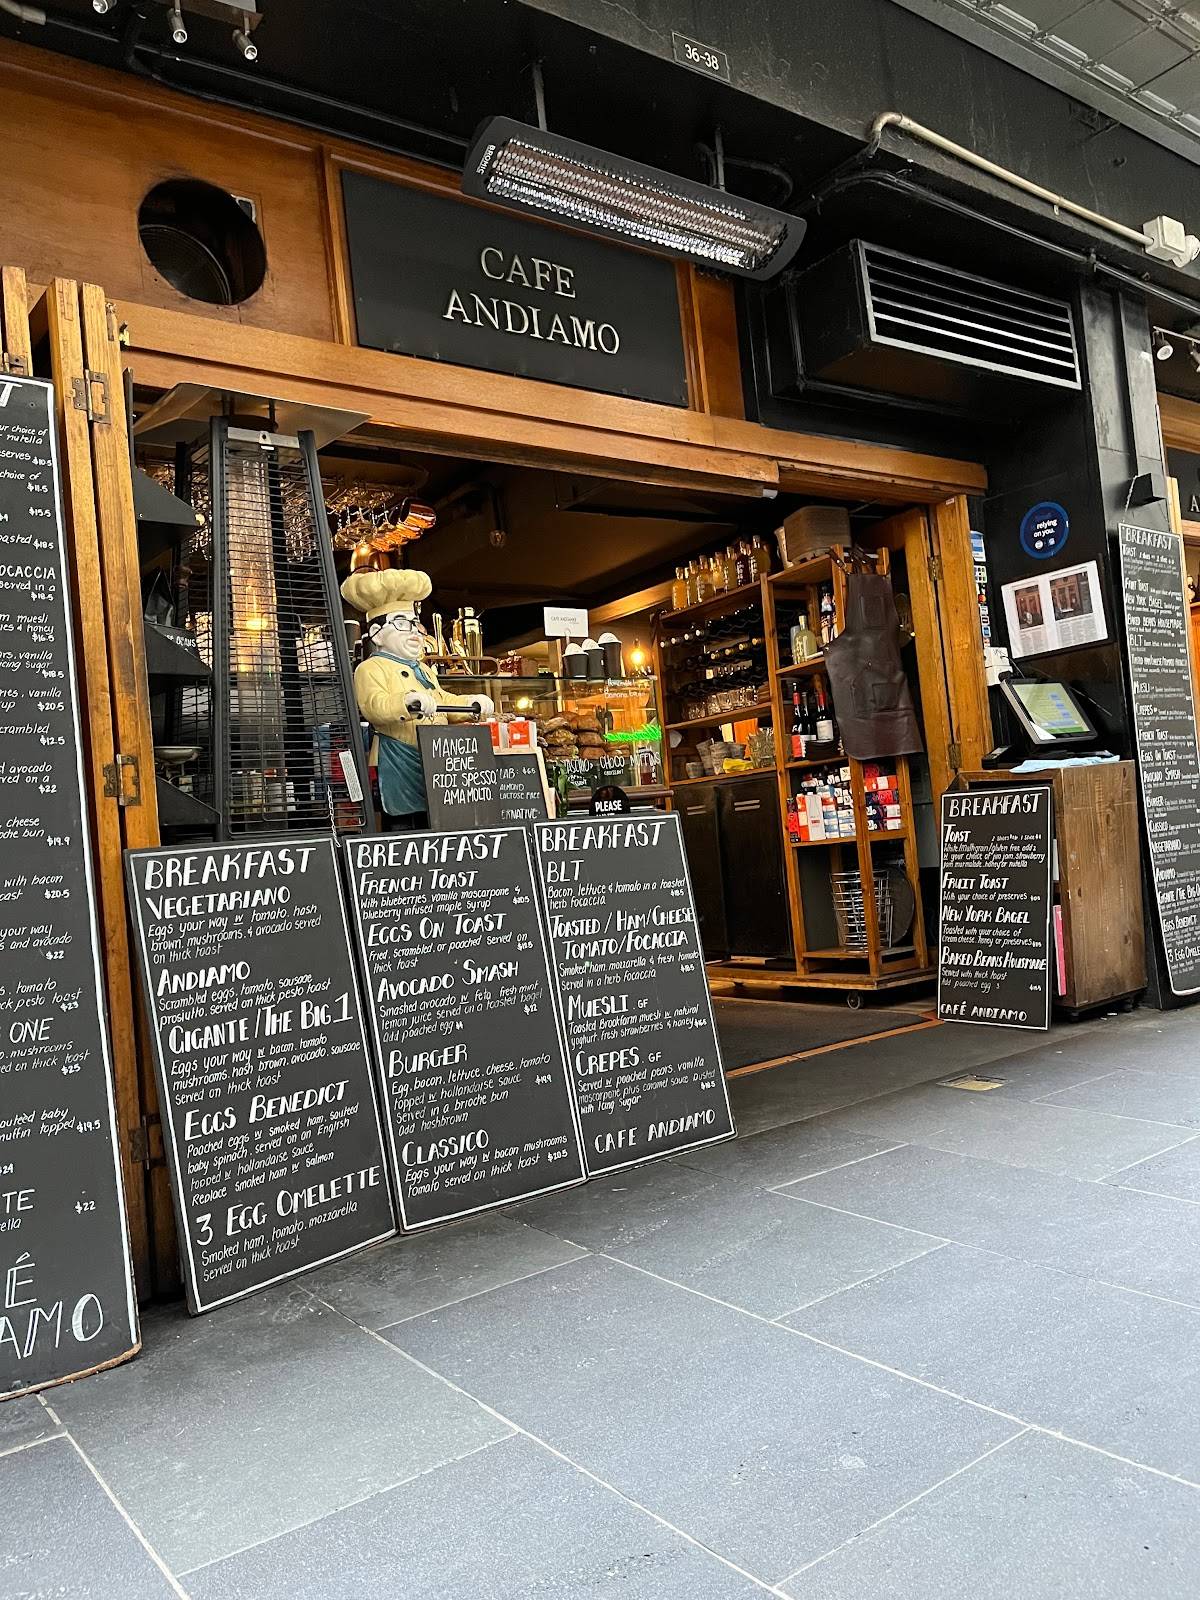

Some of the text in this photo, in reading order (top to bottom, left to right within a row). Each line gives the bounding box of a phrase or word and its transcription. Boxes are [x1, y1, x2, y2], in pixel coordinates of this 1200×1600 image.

[685, 44, 719, 70] 36-38
[480, 145, 495, 174] BROMIC
[481, 247, 576, 299] CAFE
[442, 288, 620, 355] ANDIAMO
[7, 433, 43, 445] nutella
[12, 425, 48, 436] choice of
[29, 471, 41, 481] of
[1037, 520, 1057, 529] relying
[1125, 527, 1172, 550] BREAKFAST
[17, 613, 48, 623] muesli
[26, 624, 54, 635] honey
[1129, 634, 1143, 646] BLT
[19, 650, 53, 660] vanilla
[25, 660, 50, 674] sugar
[28, 687, 62, 698] vanilla
[433, 738, 478, 758] MANGIA
[10, 764, 52, 774] avocado
[446, 757, 477, 772] BENE.
[600, 754, 624, 769] CHOCO
[26, 775, 38, 783] on
[39, 784, 57, 793] $22
[433, 774, 457, 788] RIDI
[444, 788, 465, 805] AMA
[595, 800, 622, 812] PLEASE
[949, 793, 1042, 817] BREAKFAST
[7, 817, 40, 828] cheese
[24, 829, 44, 838] bun
[541, 822, 666, 852] BREAKFAST
[944, 823, 971, 843] TOAST
[357, 833, 508, 868] BREAKFAST
[145, 848, 316, 891] BREAKFAST
[546, 859, 585, 883] BLT
[4, 874, 64, 887] with bacon
[359, 869, 478, 895] FRENCH TOAST
[942, 872, 1009, 890] FRUIT TOAST
[146, 886, 291, 920] VEGETARIANO
[381, 887, 510, 907] blueberries mascarpone
[148, 904, 317, 942] Eggs your way hash
[294, 915, 322, 930] served
[942, 905, 1031, 924] NEW YORK BAGEL
[0, 924, 53, 943] your way
[419, 916, 445, 939] ON
[453, 913, 507, 935] TOAST
[550, 915, 601, 938] TOASTED
[10, 934, 73, 949] and avocado
[46, 951, 64, 960] $22
[941, 946, 973, 966] BAKED
[973, 950, 1003, 967] BEANS
[16, 978, 57, 993] tomato
[157, 961, 250, 997] ANDIAMO
[377, 959, 519, 1002] AVOCADO SMASH
[14, 988, 83, 1013] pesto toast
[568, 994, 628, 1021] MUESLI
[940, 1001, 1027, 1022] CAFÉ ANDIAMO
[10, 1017, 54, 1043] ONE
[168, 1017, 249, 1054] GIGANTE
[301, 999, 331, 1030] BIG
[15, 1051, 90, 1072] on thick toast
[61, 1064, 81, 1076] $25
[388, 1043, 468, 1078] BURGER
[575, 1046, 639, 1076] CREPES
[249, 1080, 349, 1124] BENEDICT
[40, 1107, 69, 1126] baby
[39, 1117, 76, 1137] topped
[594, 1109, 715, 1153] CAFE ANDIAMO
[401, 1129, 489, 1167] CLASSICO
[405, 1168, 429, 1186] Eggs
[494, 1146, 519, 1159] bacon
[75, 1200, 96, 1214] $22
[196, 1165, 380, 1246] 3 EGG OMELETTE
[201, 1200, 358, 1267] Smoked mozzarella
